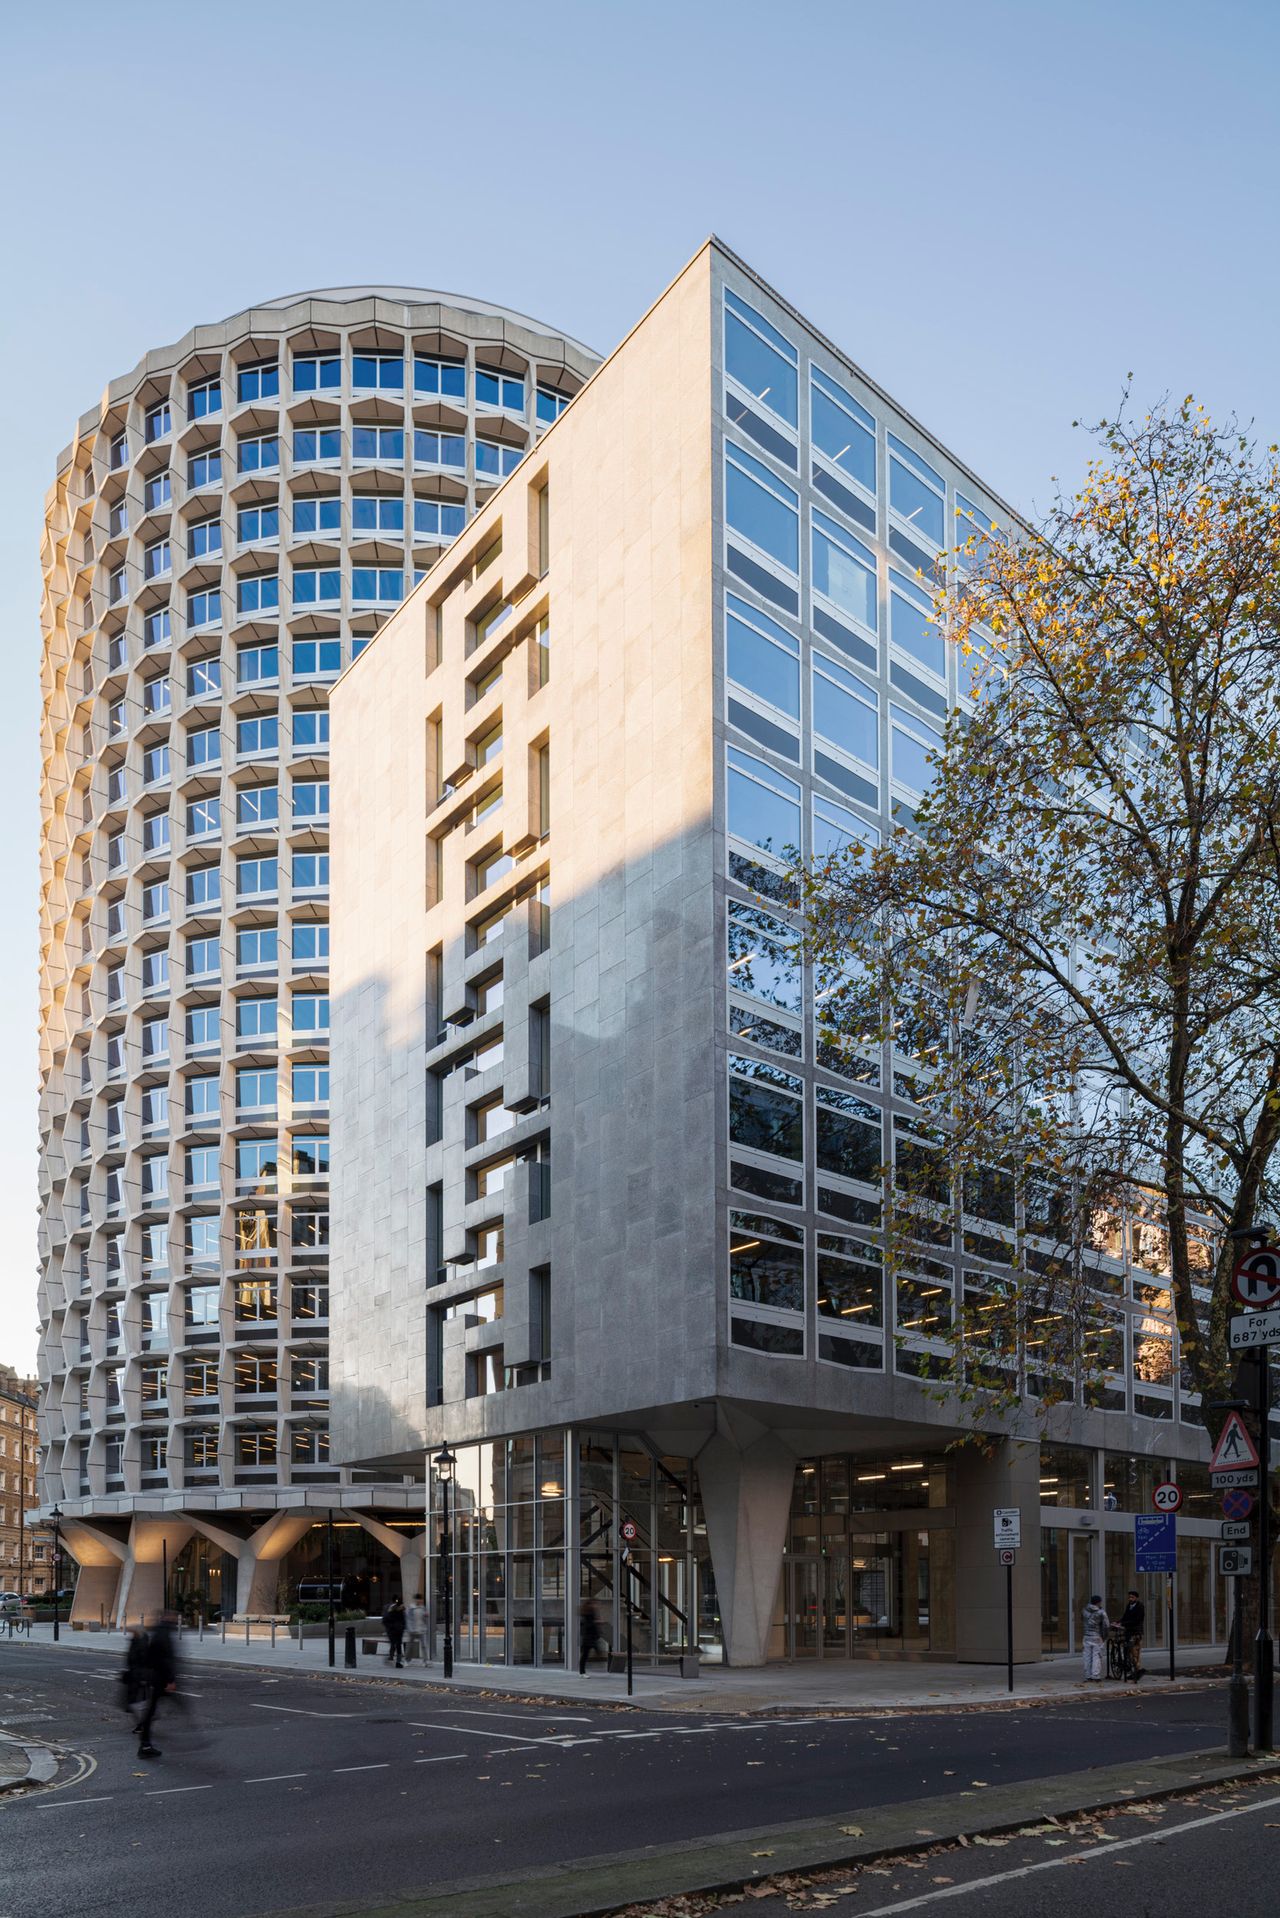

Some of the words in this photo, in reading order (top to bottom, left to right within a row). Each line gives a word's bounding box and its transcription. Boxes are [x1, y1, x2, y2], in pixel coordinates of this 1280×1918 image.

[1249, 1317, 1268, 1328] For
[1233, 1331, 1257, 1344] 687
[1262, 1328, 1280, 1340] yds
[1215, 1475, 1234, 1484] 100
[1236, 1473, 1254, 1485] yds
[1157, 1490, 1178, 1504] 20
[625, 1527, 634, 1535] 20
[1227, 1526, 1246, 1535] End
